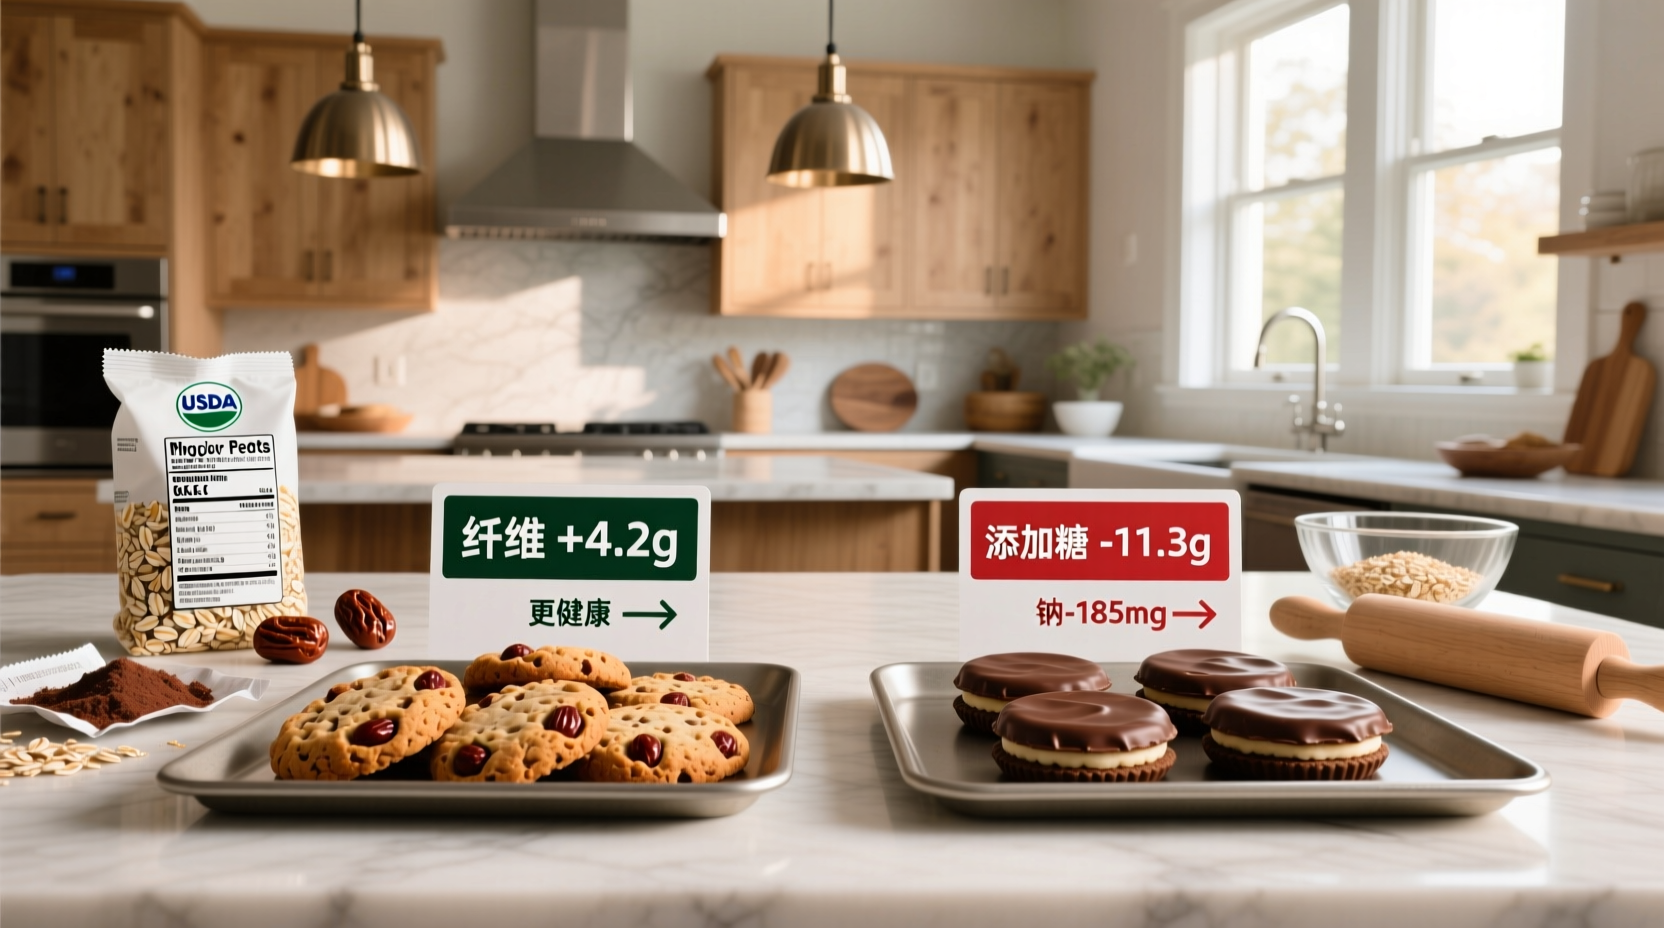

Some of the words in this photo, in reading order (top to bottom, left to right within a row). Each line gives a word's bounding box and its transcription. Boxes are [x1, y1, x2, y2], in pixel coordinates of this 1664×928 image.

[182, 393, 238, 411] USDA
[461, 515, 546, 560] 纤维
[557, 520, 678, 568] +4.2g
[985, 523, 1089, 560] 添加糖
[1100, 526, 1211, 566] -11.3g
[528, 597, 611, 628] 更健康
[1036, 597, 1167, 631] 钠-185mg
